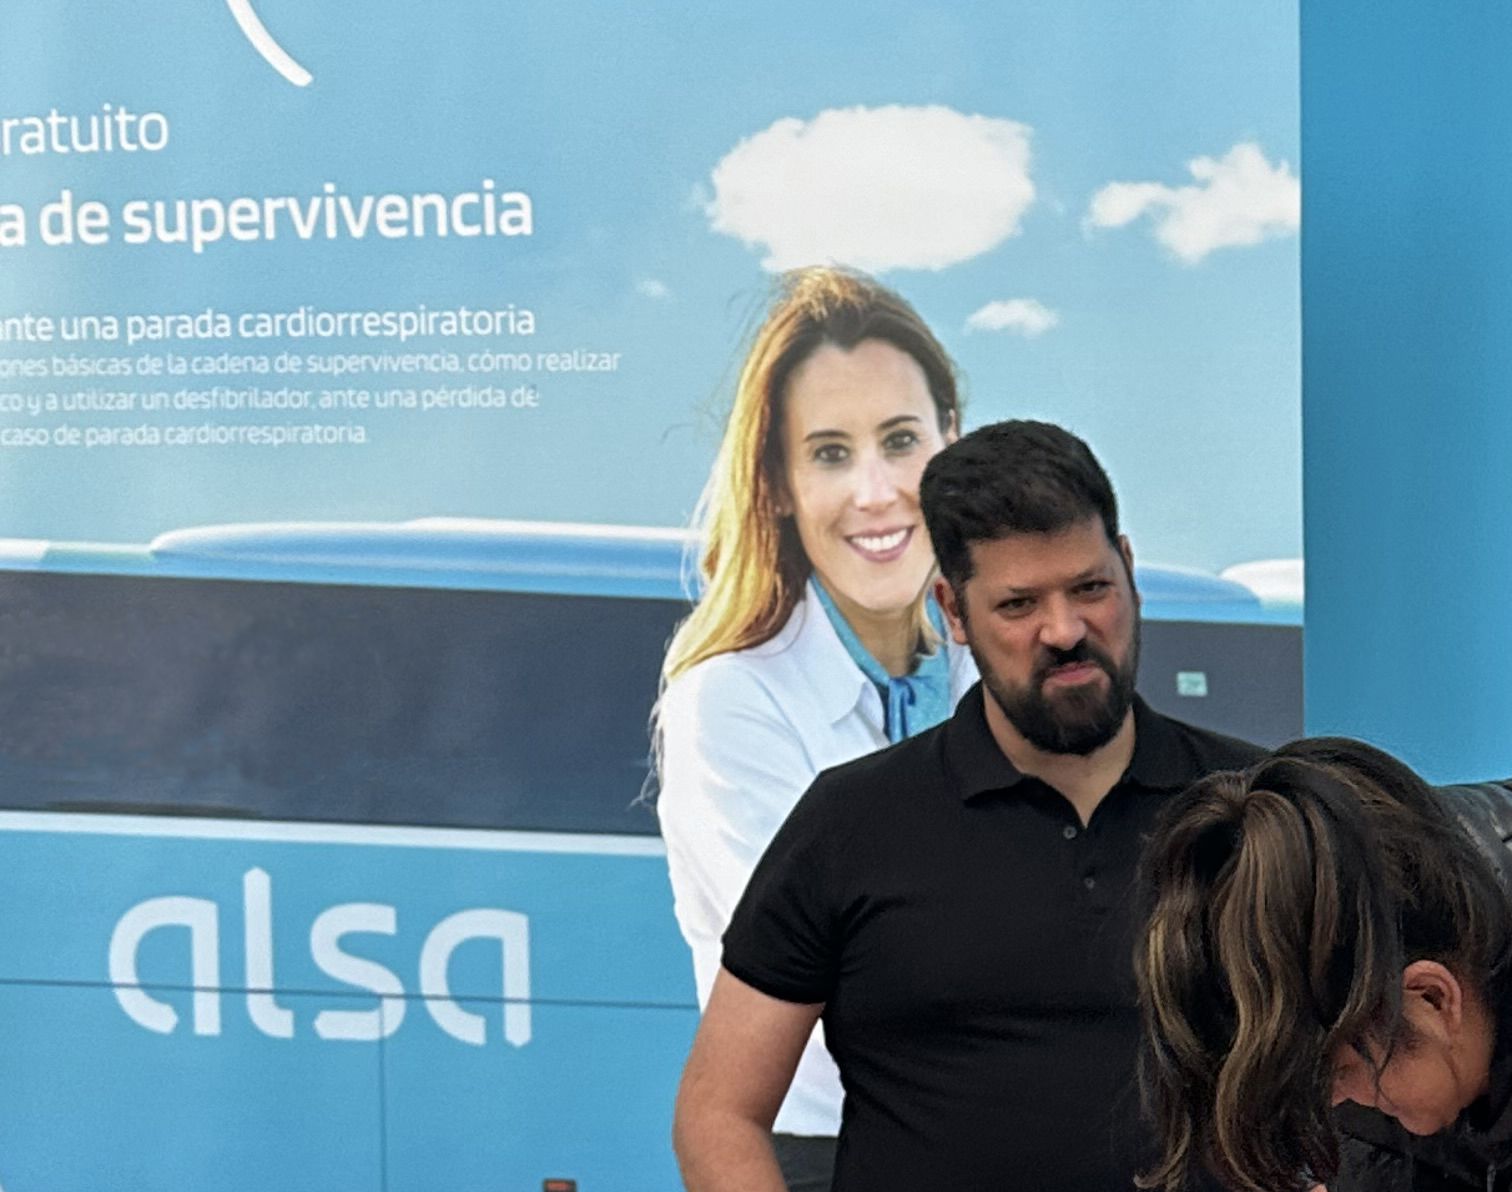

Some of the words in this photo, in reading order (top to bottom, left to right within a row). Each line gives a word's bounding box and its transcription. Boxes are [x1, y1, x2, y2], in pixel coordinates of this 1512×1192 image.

[39, 189, 110, 245] de
[123, 179, 533, 254] supervivencia
[0, 312, 54, 342] nte
[61, 315, 119, 341] una
[127, 308, 232, 345] parada
[238, 303, 537, 342] cardiorrespiratoria
[52, 352, 132, 377] básicas
[136, 353, 163, 375] de
[167, 353, 188, 375] la
[192, 352, 270, 375] cadena
[274, 351, 302, 374] de
[468, 349, 533, 373] cómo
[536, 349, 622, 372] realizar
[27, 392, 42, 416] y
[46, 392, 58, 411] a
[63, 387, 138, 411] utilizar
[141, 391, 170, 411] un
[319, 387, 370, 410] ante
[374, 388, 417, 409] una
[421, 383, 507, 411] pérdida
[510, 385, 541, 408] de
[53, 424, 81, 447] de
[84, 422, 160, 448] parada
[108, 867, 532, 1048] alsa
